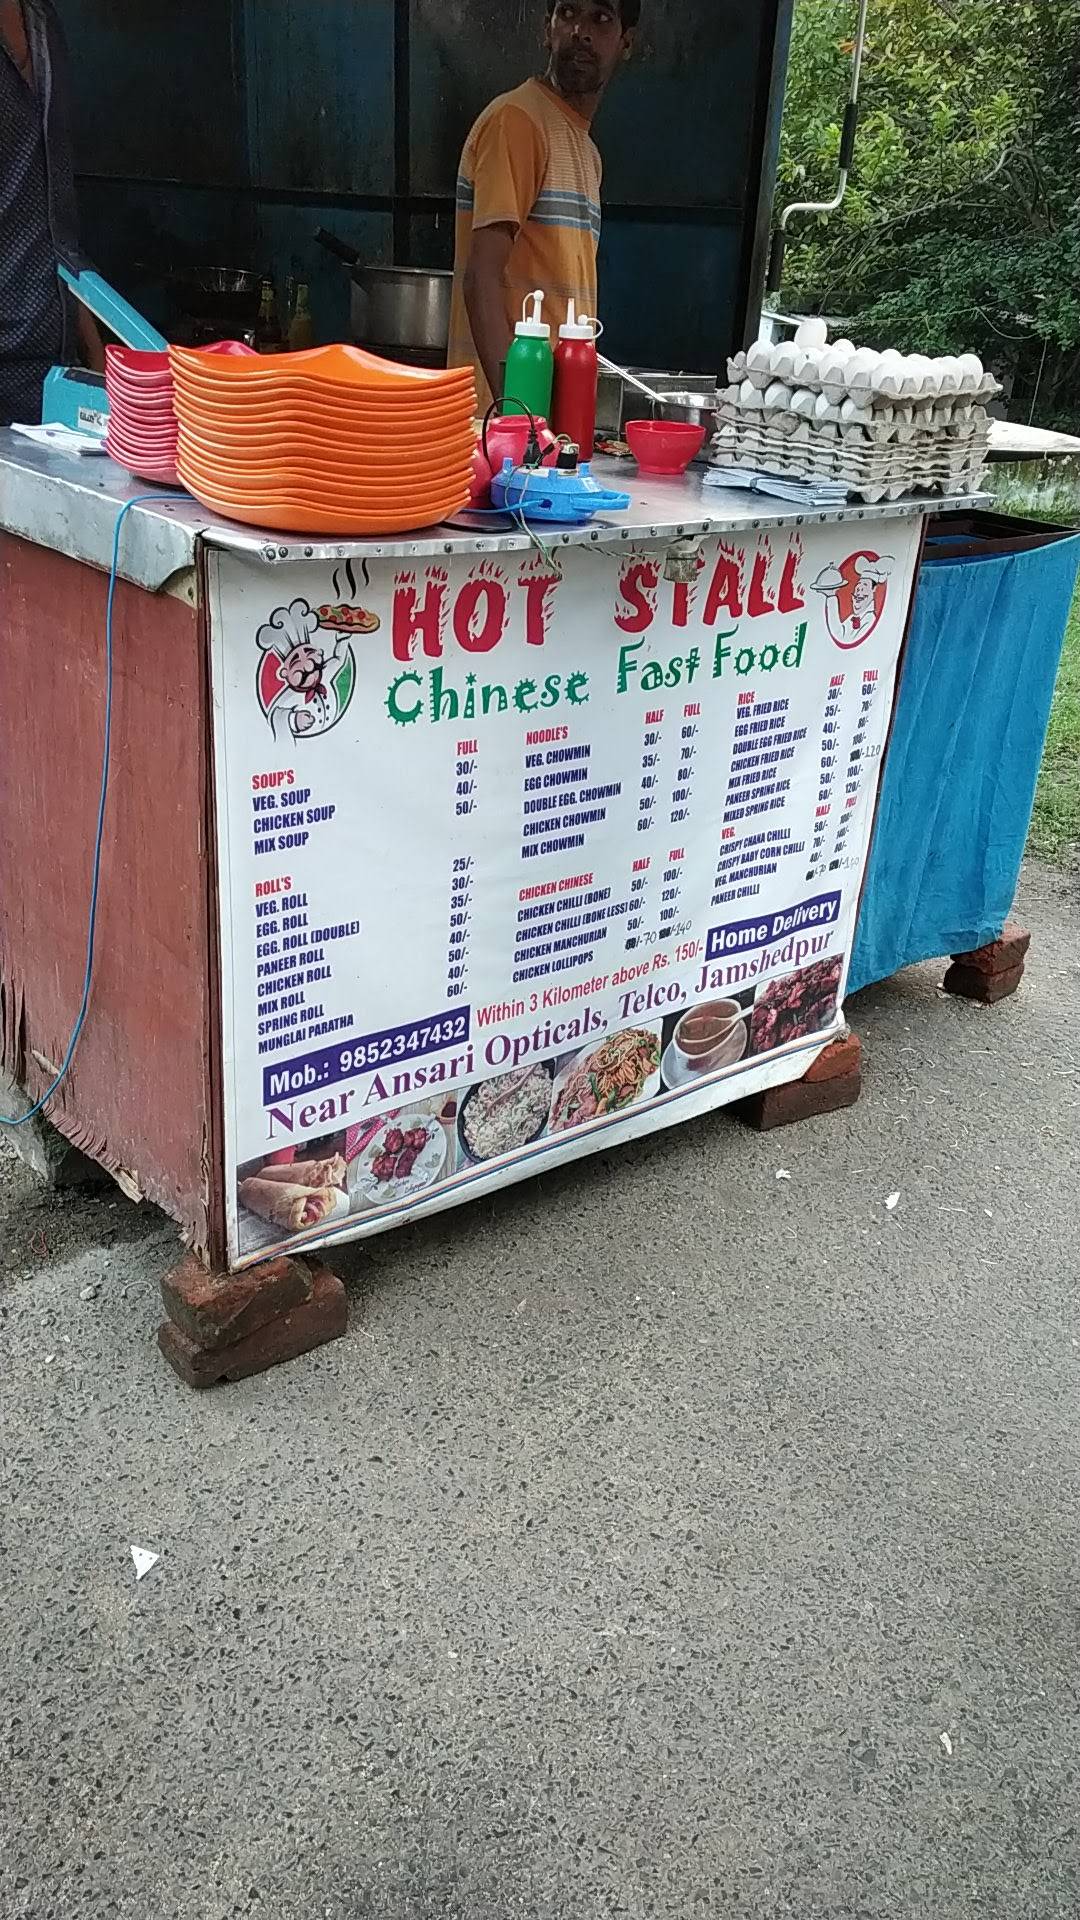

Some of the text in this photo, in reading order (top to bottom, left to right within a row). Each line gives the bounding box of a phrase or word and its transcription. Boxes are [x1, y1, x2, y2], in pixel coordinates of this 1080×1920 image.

[391, 533, 805, 662] HOT STALL
[384, 621, 808, 727] Chinese Fast Food
[829, 669, 878, 687] HALF FULL
[738, 691, 755, 705] RICE
[828, 683, 876, 700] 30/- 60/-
[645, 702, 701, 724] HALF FULL
[737, 698, 789, 719] VEG. FRIED RICE
[825, 704, 841, 717] 35/-
[526, 726, 569, 745] NOODLE'S
[644, 724, 699, 746] 30/- 60/-
[734, 716, 786, 737] EGG FRIED RICE
[823, 721, 840, 734] 40/-
[457, 739, 478, 756] FULL
[733, 727, 808, 755] DOUBLE EGG FRIED RICE
[821, 738, 839, 751] 50/-
[456, 759, 478, 776] 30/-
[525, 744, 591, 769] VEG. CHOWMIN
[642, 746, 697, 768] 35/- 70/-
[730, 746, 795, 772] CHICKEN FRIED RICE
[821, 755, 837, 768] 60/-
[252, 769, 295, 790] SOUP'S
[456, 779, 477, 796] 40/-
[524, 767, 588, 791] EGG CHOWMIN
[641, 766, 695, 789] 40/- 80/-
[728, 767, 777, 790] MIX FRIED RICE
[820, 771, 835, 785] 50/-
[252, 788, 311, 811] VEG. SOUP
[523, 782, 621, 814] DOUBLE EGG. CHOWMIN
[639, 787, 692, 811] 50/- 100/-
[725, 779, 791, 806] PANEER SPRING RICE
[253, 805, 336, 833] CHICKEN SOUP
[456, 799, 477, 816] 50/-
[637, 808, 690, 831] 60/- 120/-
[723, 796, 785, 823] MIXED SPRING RICE
[815, 803, 831, 817] HALF
[523, 808, 606, 837] CHICKEN CHOWMIN
[721, 827, 735, 840] VEG.
[254, 831, 309, 855] MIX SOUP
[521, 833, 585, 859] MIX CHOWMIN
[720, 839, 743, 856] CRISPY
[766, 828, 791, 842] CHILLI
[452, 856, 475, 872] 25/-
[632, 848, 685, 872] HALF FULL
[717, 841, 805, 872] CRISPY BABY CORN CHILLI
[452, 875, 474, 891] 30/-
[631, 867, 683, 892] 50/- 100/-
[728, 862, 777, 883] MANCHURIAN
[255, 876, 292, 897] ROLL'S
[519, 872, 594, 901] CHICKEN CHINESE
[710, 883, 760, 907] PANEER CHILLI
[255, 893, 308, 917] VEG. ROLL
[451, 893, 473, 909] 35/-
[517, 902, 555, 922] CHICKEN
[556, 895, 583, 912] CHILLI
[629, 887, 681, 911] 60/- 120/-
[256, 913, 309, 938] EGG. ROLL
[450, 911, 472, 927] 50/-
[516, 922, 553, 942] CHICKEN
[554, 915, 581, 932] CHILLI
[627, 906, 679, 931] 50/- 100/-
[710, 925, 767, 953] Home
[771, 900, 837, 937] Delivery
[256, 941, 280, 958] EGG.
[283, 933, 309, 951] ROLL
[449, 929, 471, 945] 40/-
[514, 942, 552, 963] CHICKEN
[553, 926, 608, 953] MANCHURIAN
[256, 948, 325, 978] PANEER ROLL
[448, 947, 470, 963] 50/-
[512, 950, 594, 983] CHICKEN LOLLIPOPS
[257, 965, 331, 997] CHICKEN ROLL
[448, 964, 469, 980] 40/-
[476, 939, 704, 1027] Within 3 Kilometer above Rs. 150/-
[447, 981, 468, 997] 60/-
[257, 991, 306, 1017] MIX ROLL
[257, 1004, 324, 1036] SPRING ROLL
[258, 1014, 354, 1054] MUNGLAI PARATHA
[265, 930, 834, 1140] Near Ansari Opticals, Telco, Jamshedpur
[270, 1016, 465, 1096] Mob.: 9852347432
